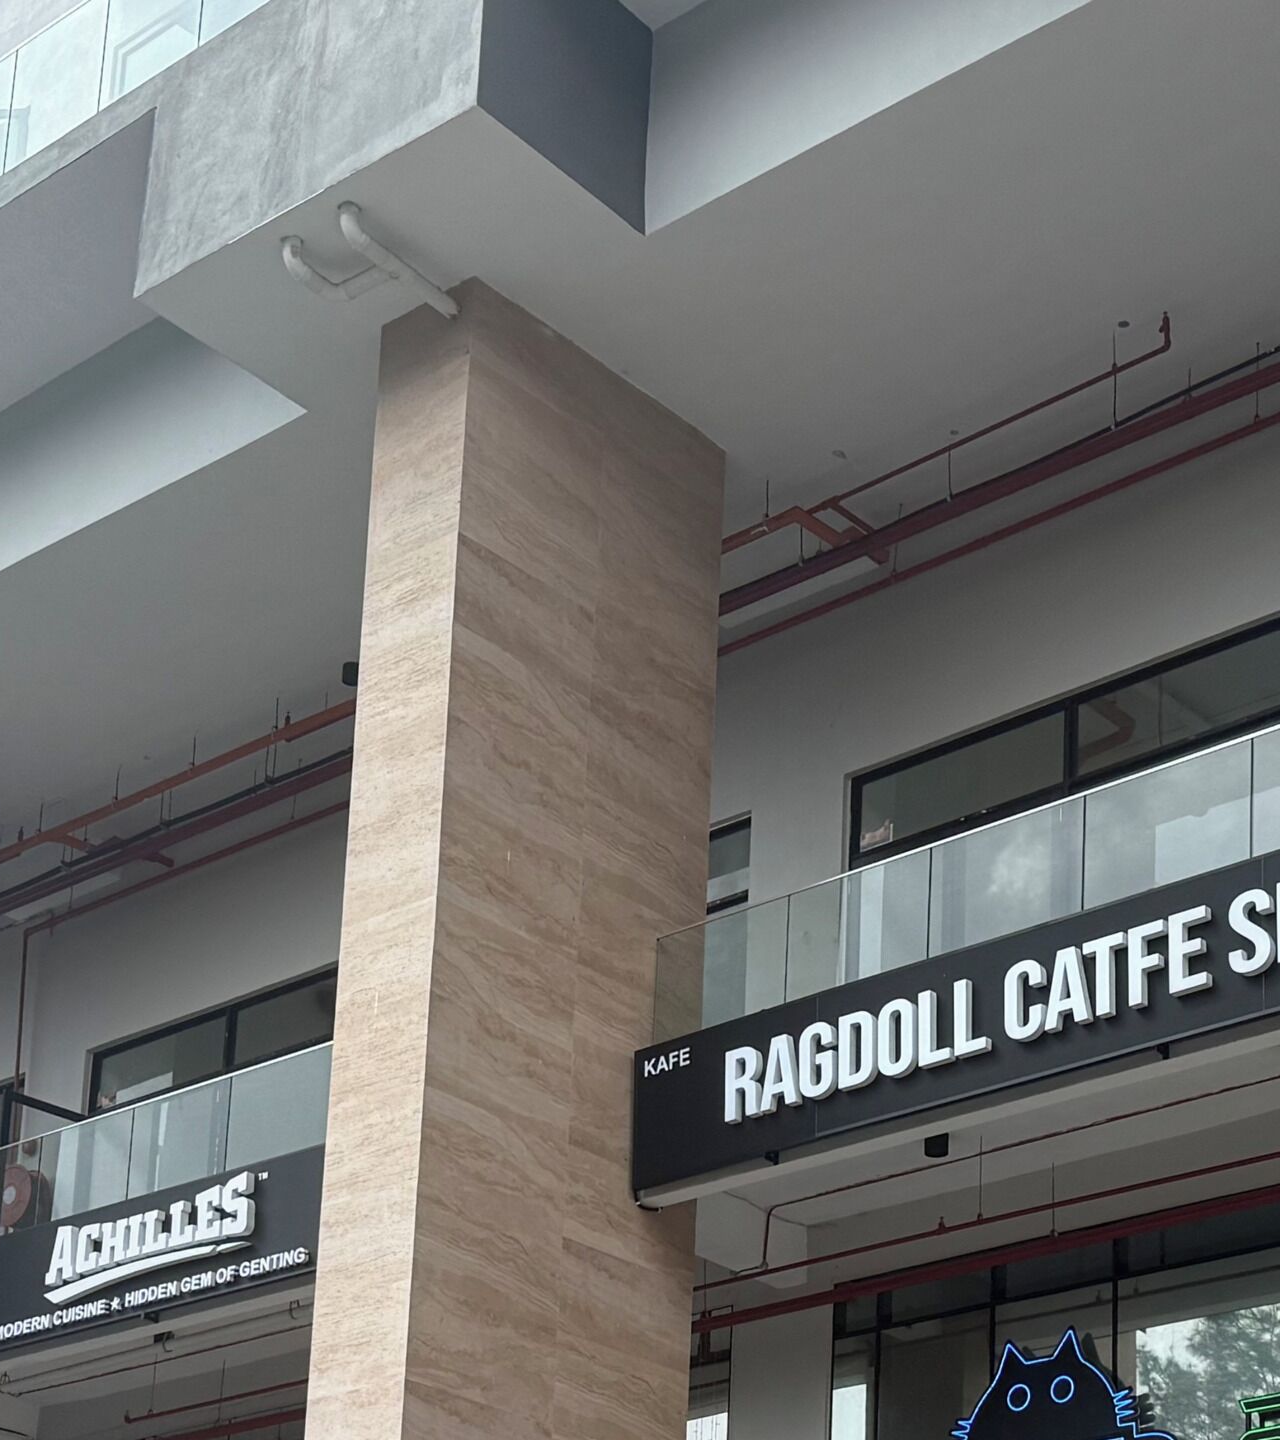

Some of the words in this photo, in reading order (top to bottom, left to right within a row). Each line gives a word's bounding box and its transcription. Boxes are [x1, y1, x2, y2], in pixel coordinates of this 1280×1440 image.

[643, 1045, 691, 1079] KAFE
[721, 976, 992, 1125] RAGDOLL
[1003, 904, 1214, 1042] CATFE
[44, 1171, 257, 1287] ACHILLES
[53, 1300, 108, 1327] CUISINE
[124, 1279, 177, 1309] HIDDEN
[180, 1270, 212, 1296] GEM
[216, 1268, 238, 1284] OF
[239, 1246, 309, 1279] GENTING
